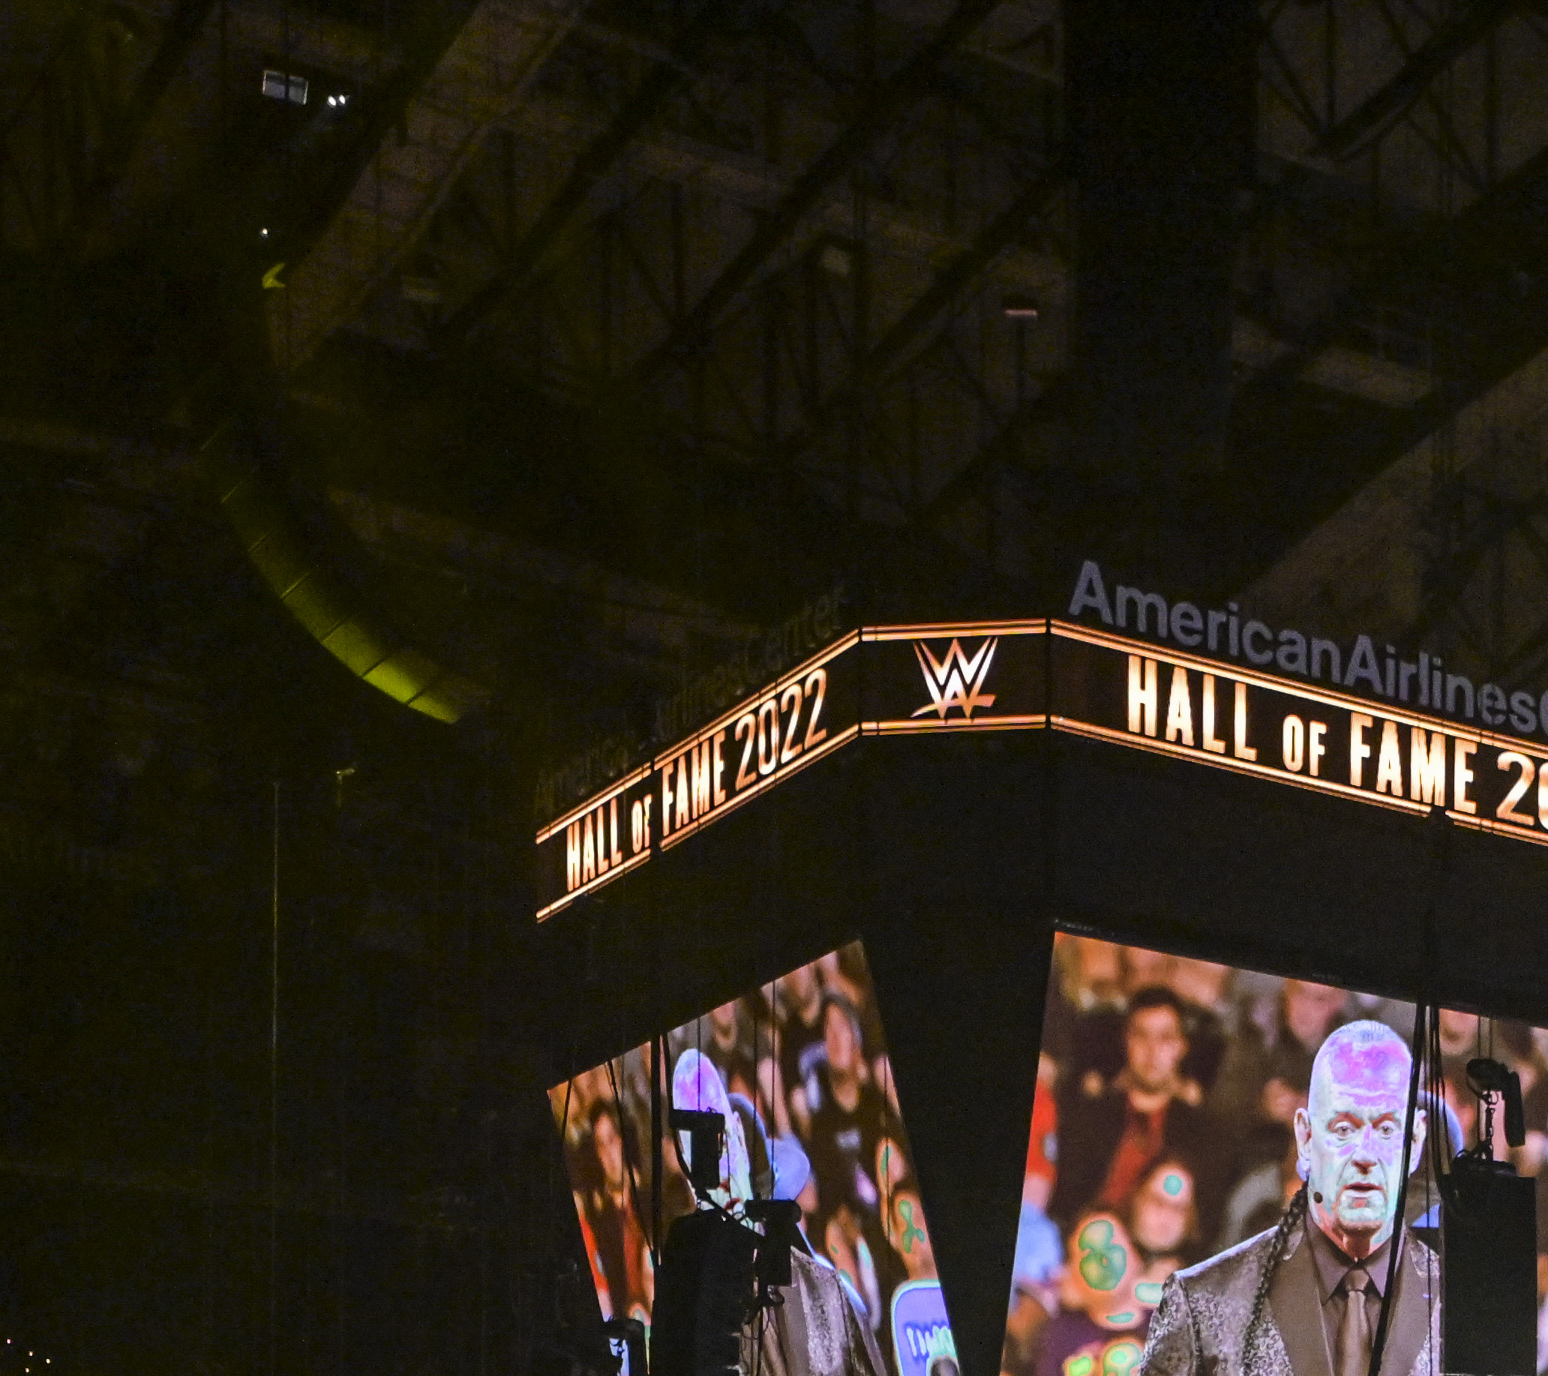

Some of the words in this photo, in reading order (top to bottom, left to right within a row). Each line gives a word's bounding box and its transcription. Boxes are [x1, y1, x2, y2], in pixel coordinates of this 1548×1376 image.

[567, 799, 622, 891] HALL
[631, 794, 652, 853] OF
[662, 729, 727, 836] FAME
[735, 668, 827, 791] 2022
[1126, 654, 1257, 761] HALL
[1282, 714, 1326, 775] OF
[1350, 711, 1477, 814] FAME
